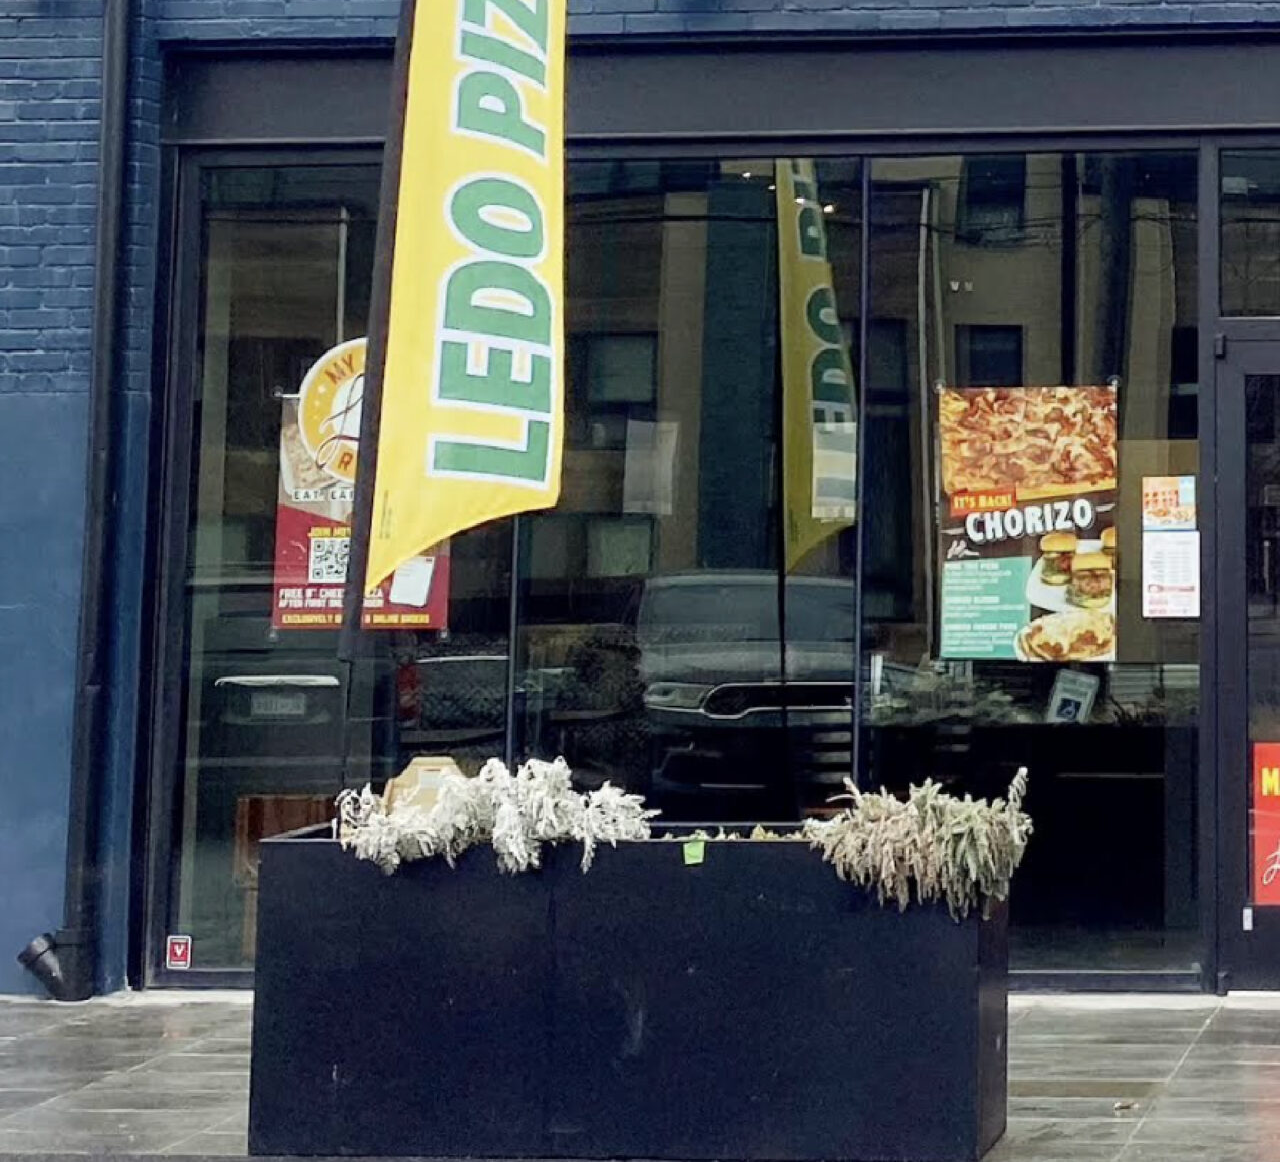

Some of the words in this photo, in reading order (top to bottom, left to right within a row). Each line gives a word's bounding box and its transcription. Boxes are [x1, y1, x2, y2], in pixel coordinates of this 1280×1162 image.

[429, 173, 552, 488] LEDO
[954, 495, 976, 509] IT'S
[966, 498, 1093, 542] CHORIZO
